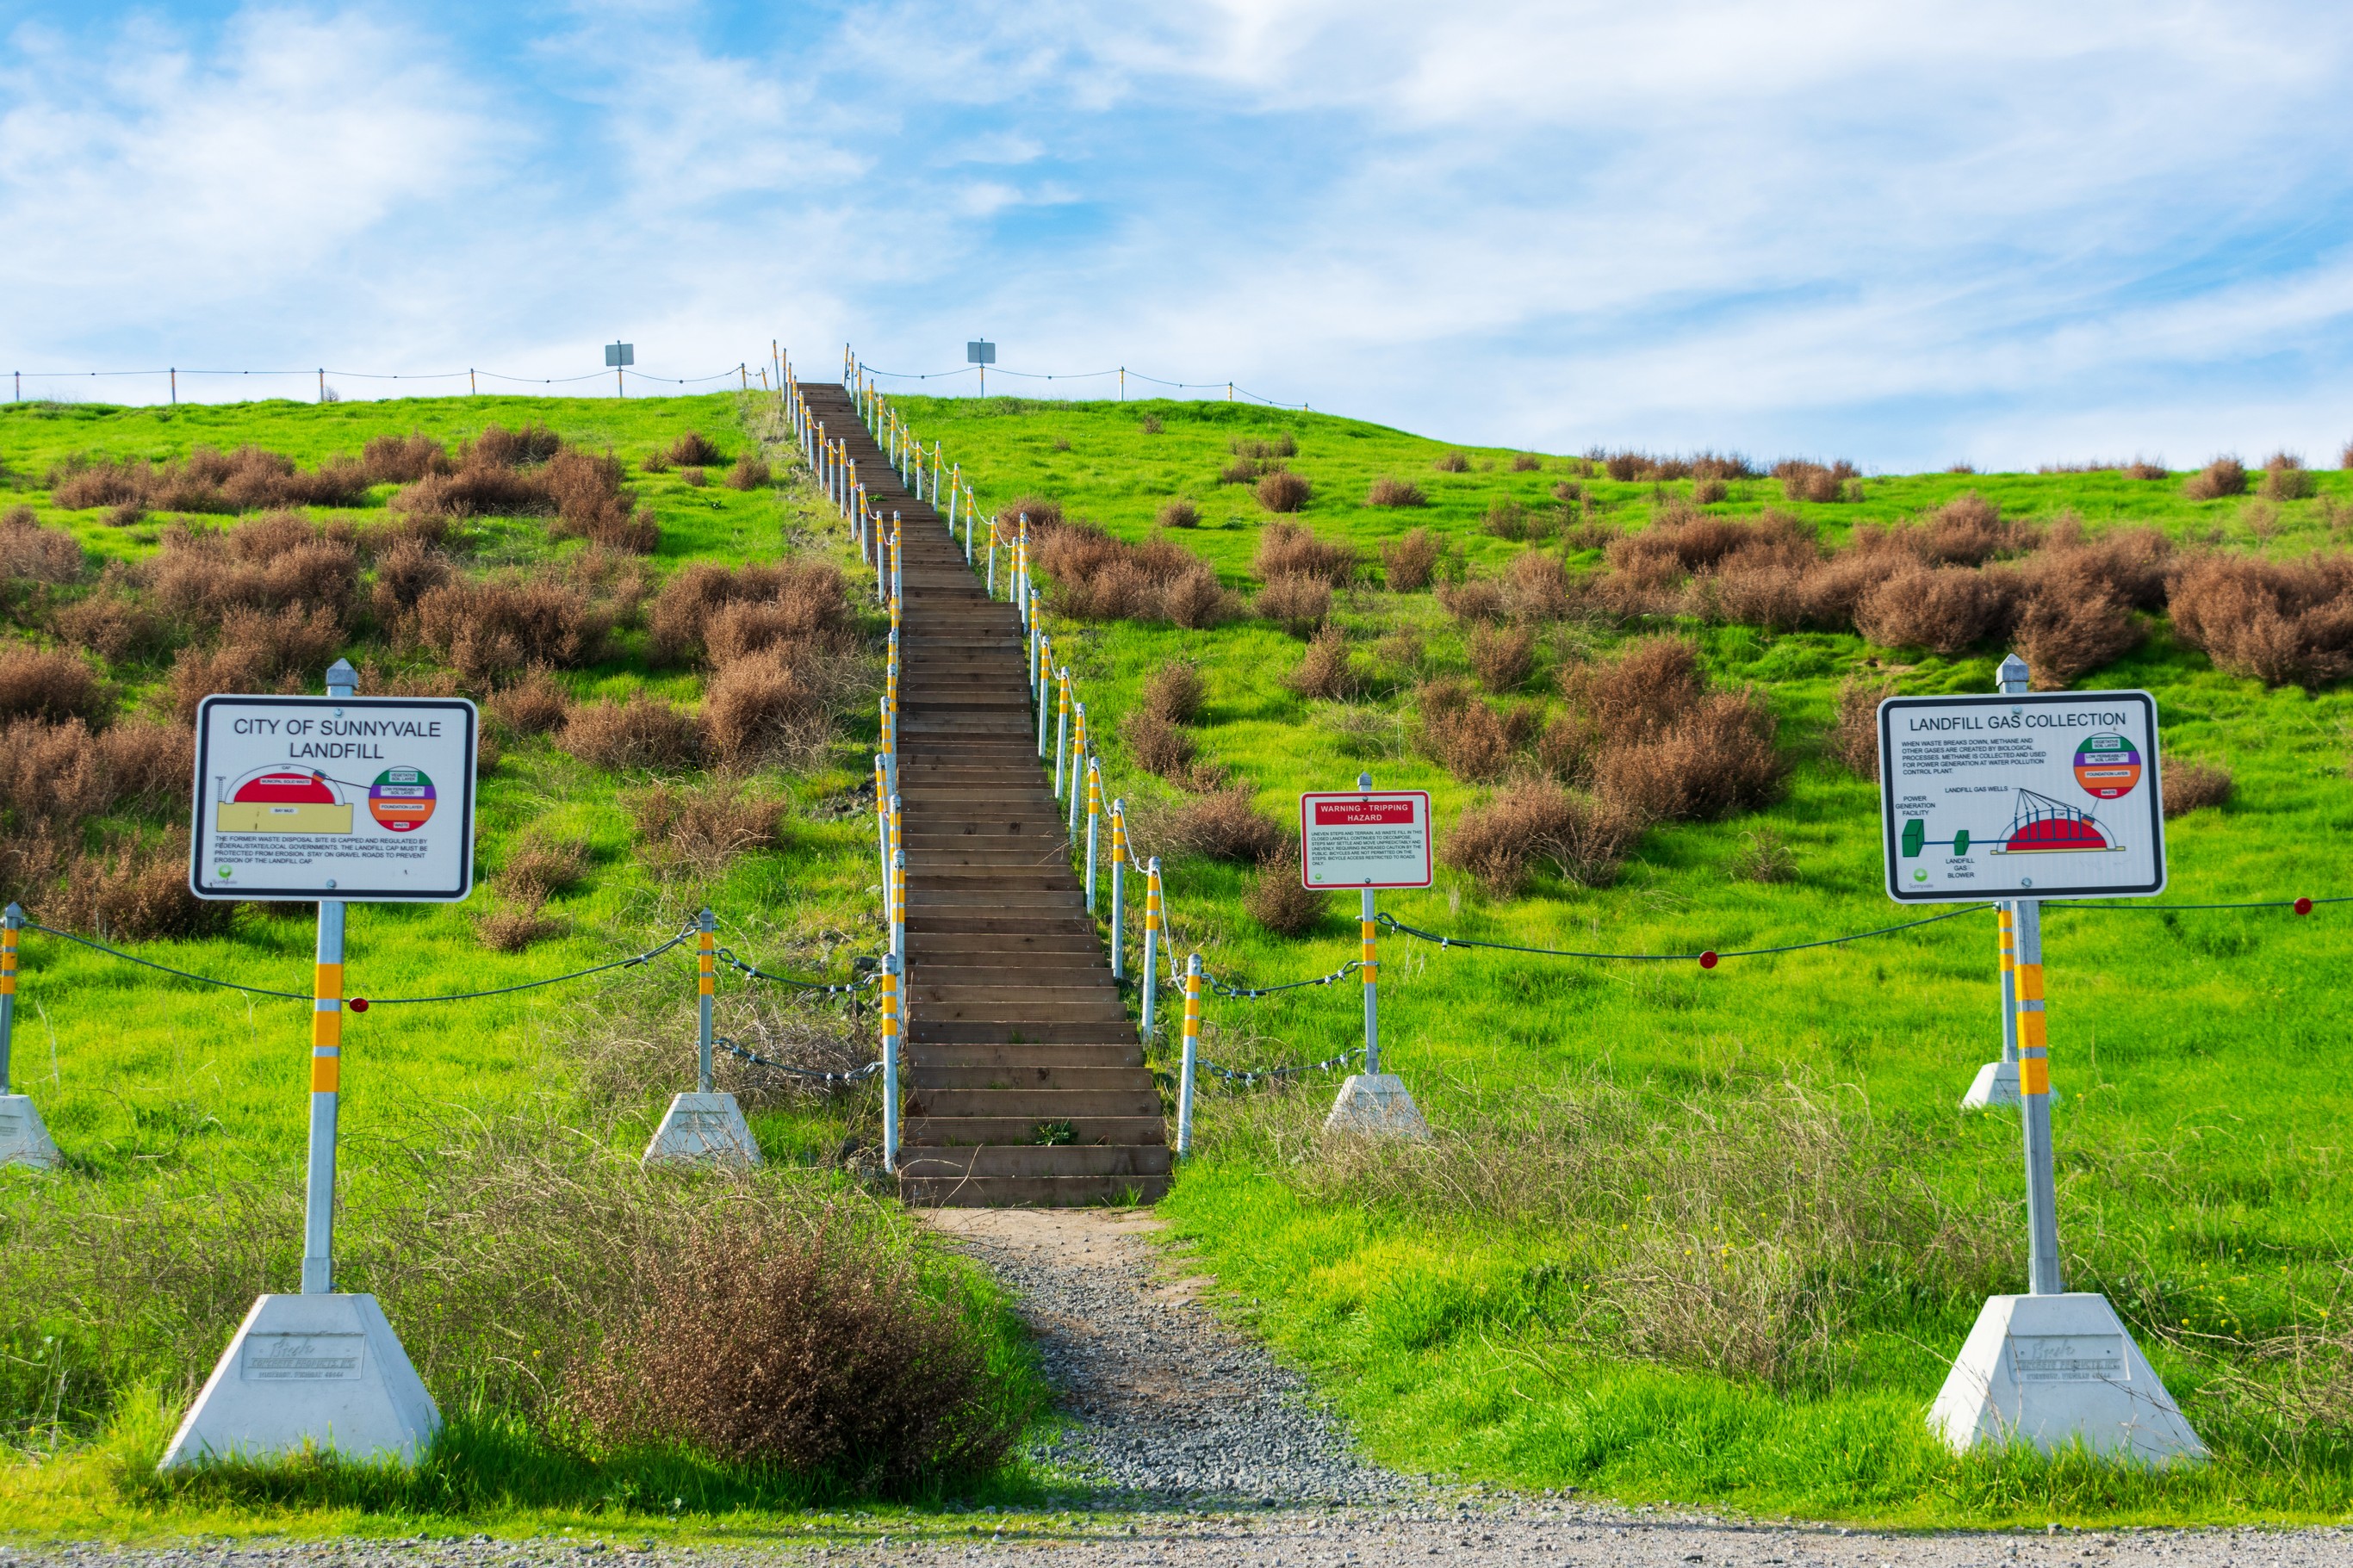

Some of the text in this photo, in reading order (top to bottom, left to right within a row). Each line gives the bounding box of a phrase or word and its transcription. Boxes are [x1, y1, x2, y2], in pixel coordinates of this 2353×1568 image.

[234, 719, 441, 737] CITY OF SUNNYVALE
[1911, 713, 2125, 731] LANDFILL GAS COLLECTION
[290, 743, 384, 759] LANDFILL
